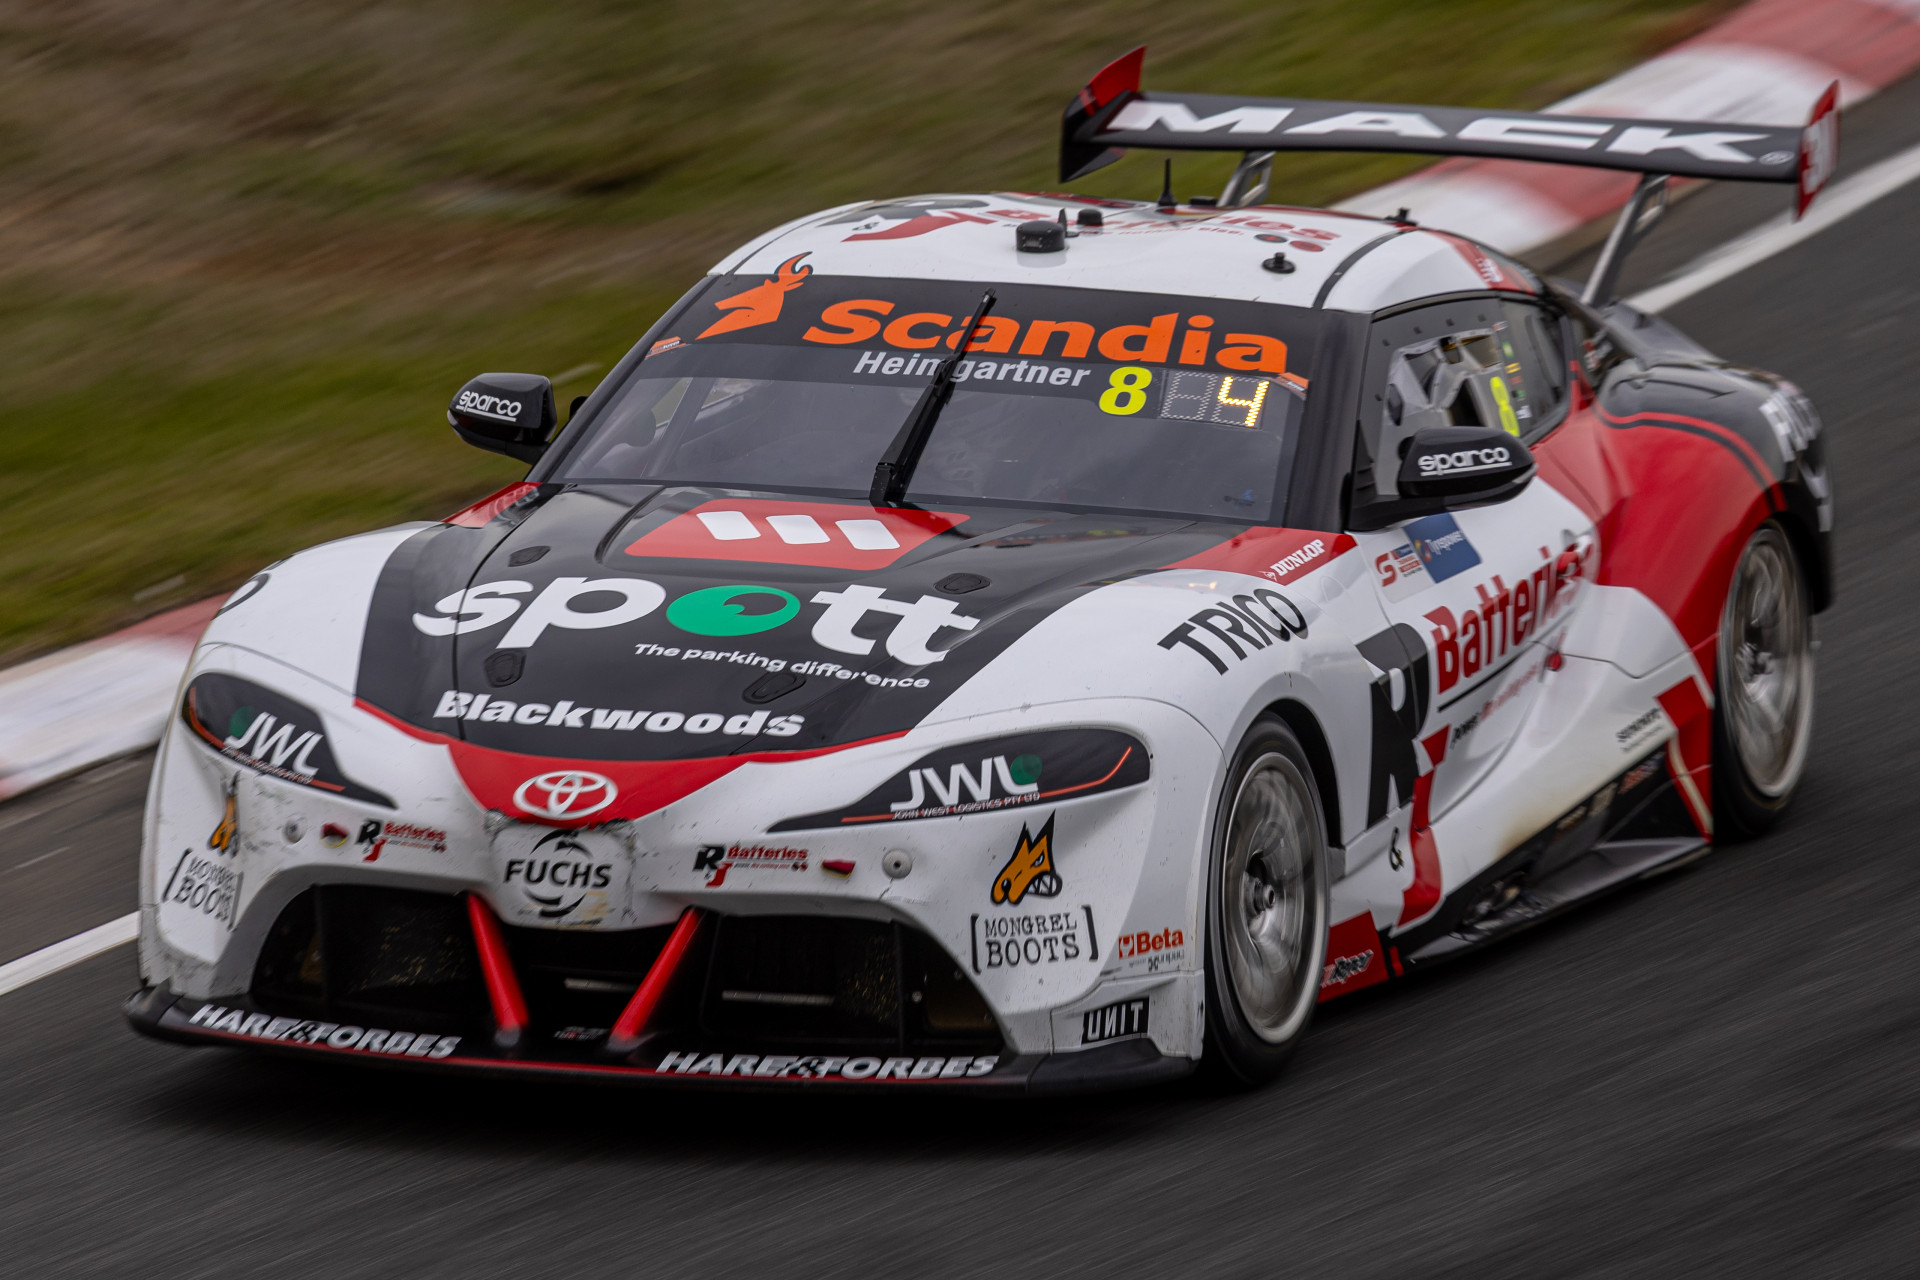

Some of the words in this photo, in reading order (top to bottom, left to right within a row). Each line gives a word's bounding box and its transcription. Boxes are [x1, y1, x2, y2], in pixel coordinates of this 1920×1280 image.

[1107, 100, 1772, 163] MACK
[803, 298, 1288, 373] Scandia
[458, 390, 523, 417] sparco
[853, 351, 1091, 387] Heimgartner
[1099, 366, 1152, 416] 8
[1217, 375, 1270, 428] 4
[1417, 446, 1510, 475] sparco
[1269, 538, 1326, 577] DUNLOP
[411, 576, 981, 666] spott
[1157, 588, 1309, 676] TRICO
[634, 643, 681, 657] The
[681, 649, 788, 673] parking
[790, 661, 931, 689] difference
[433, 690, 804, 738] Blackwoods
[223, 711, 324, 777] JWL
[890, 754, 1039, 812] JWL
[503, 859, 613, 889] FUCHS
[727, 844, 809, 861] Batteries
[984, 912, 1078, 939] MONGREL
[1136, 926, 1184, 956] Beta
[986, 932, 1081, 970] BOOTS
[1087, 1001, 1144, 1041] UNIT
